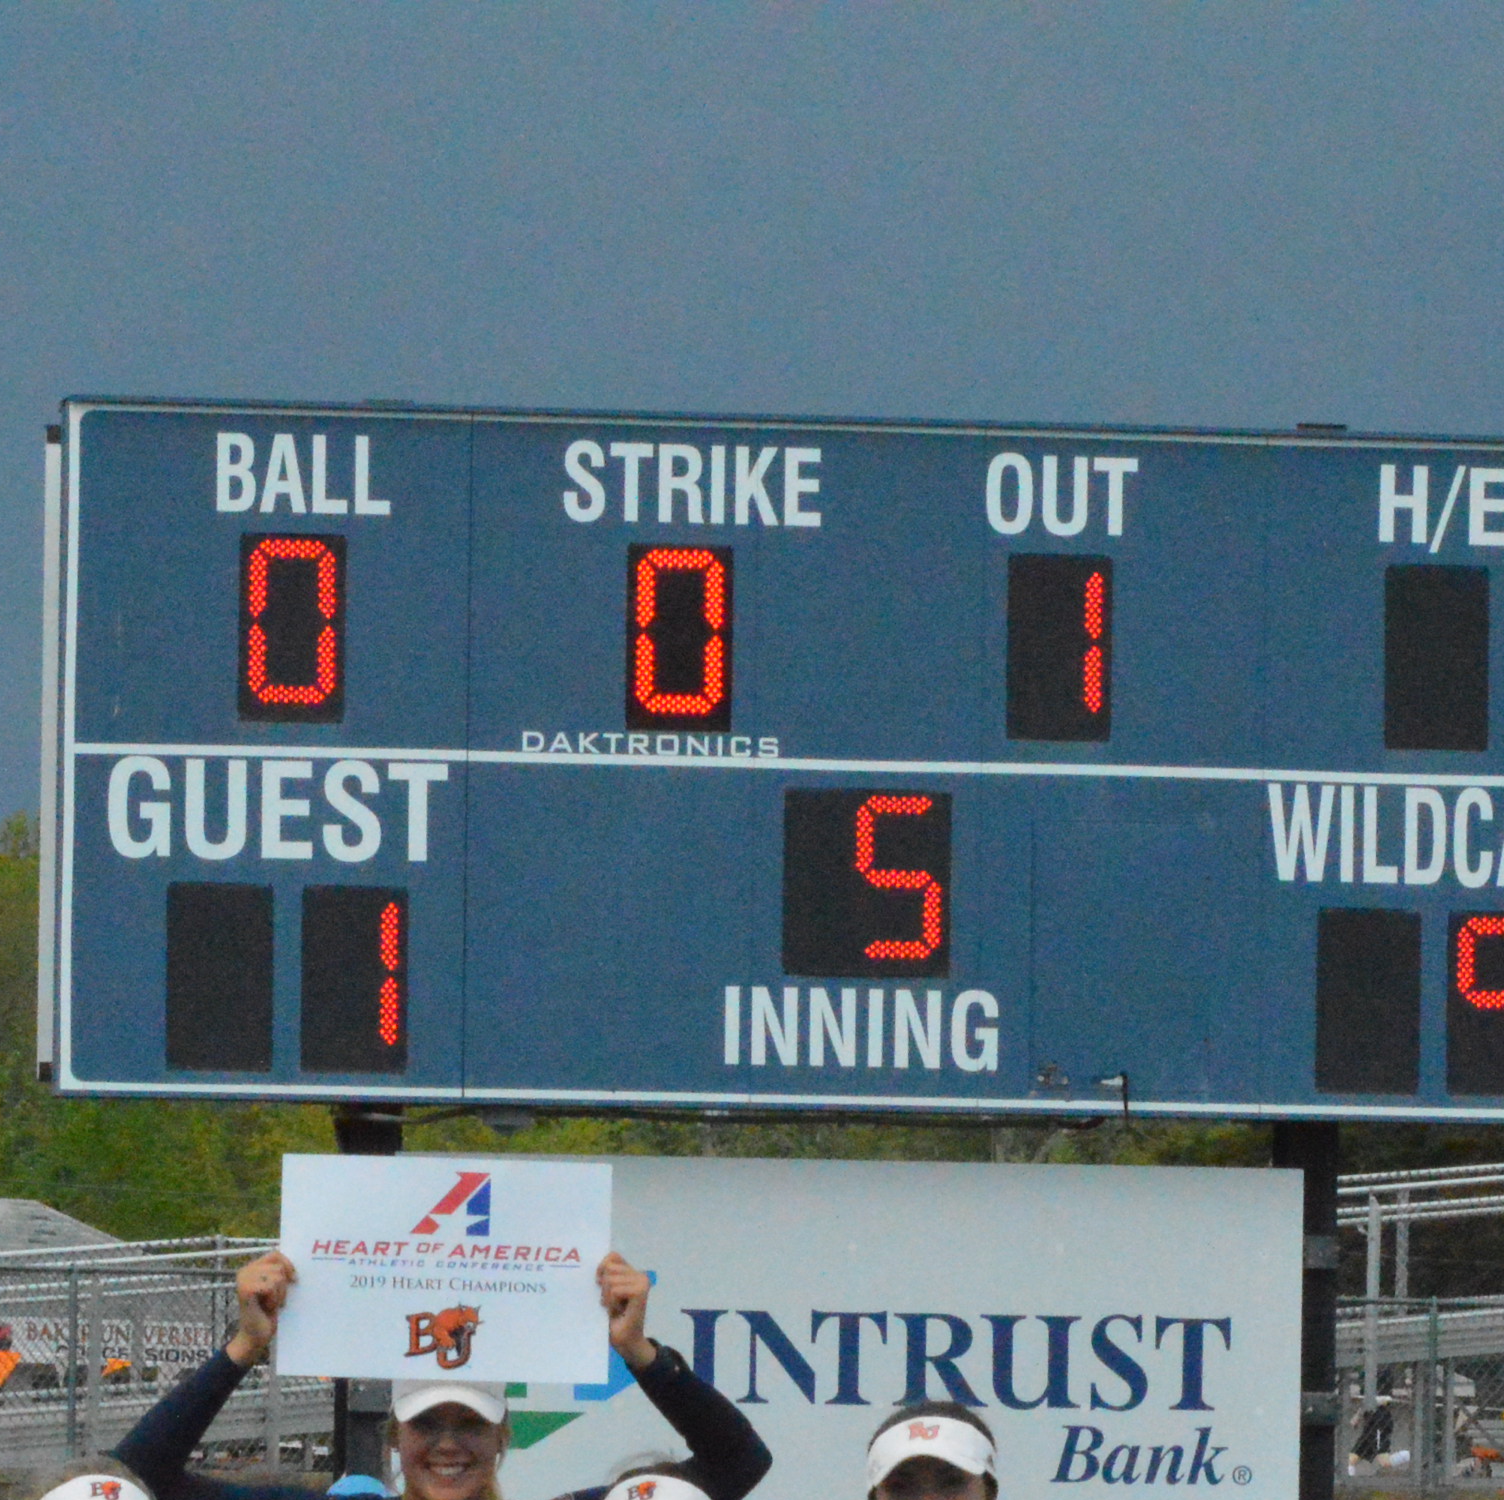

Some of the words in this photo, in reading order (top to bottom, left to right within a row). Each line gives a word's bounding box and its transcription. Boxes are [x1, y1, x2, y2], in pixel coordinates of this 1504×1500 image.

[215, 432, 391, 516] BALL
[562, 440, 822, 528] STRIKE
[984, 452, 1139, 537] OUT
[247, 538, 337, 705] 0
[635, 549, 724, 715] 0
[1083, 571, 1105, 713] 1
[521, 730, 779, 757] DAKTRONICS
[107, 755, 449, 863] GUEST
[855, 795, 943, 960] 5
[378, 901, 400, 1046] 1
[723, 985, 999, 1072] INNING
[312, 1238, 410, 1257] HEART
[416, 1242, 444, 1254] OF
[447, 1244, 581, 1262] AMERICA
[350, 1275, 386, 1288] 2019
[392, 1276, 442, 1290] HEART
[449, 1279, 546, 1292] CHAMPIONS
[680, 1308, 1232, 1412] INTRUST
[1049, 1424, 1229, 1486] Bank
